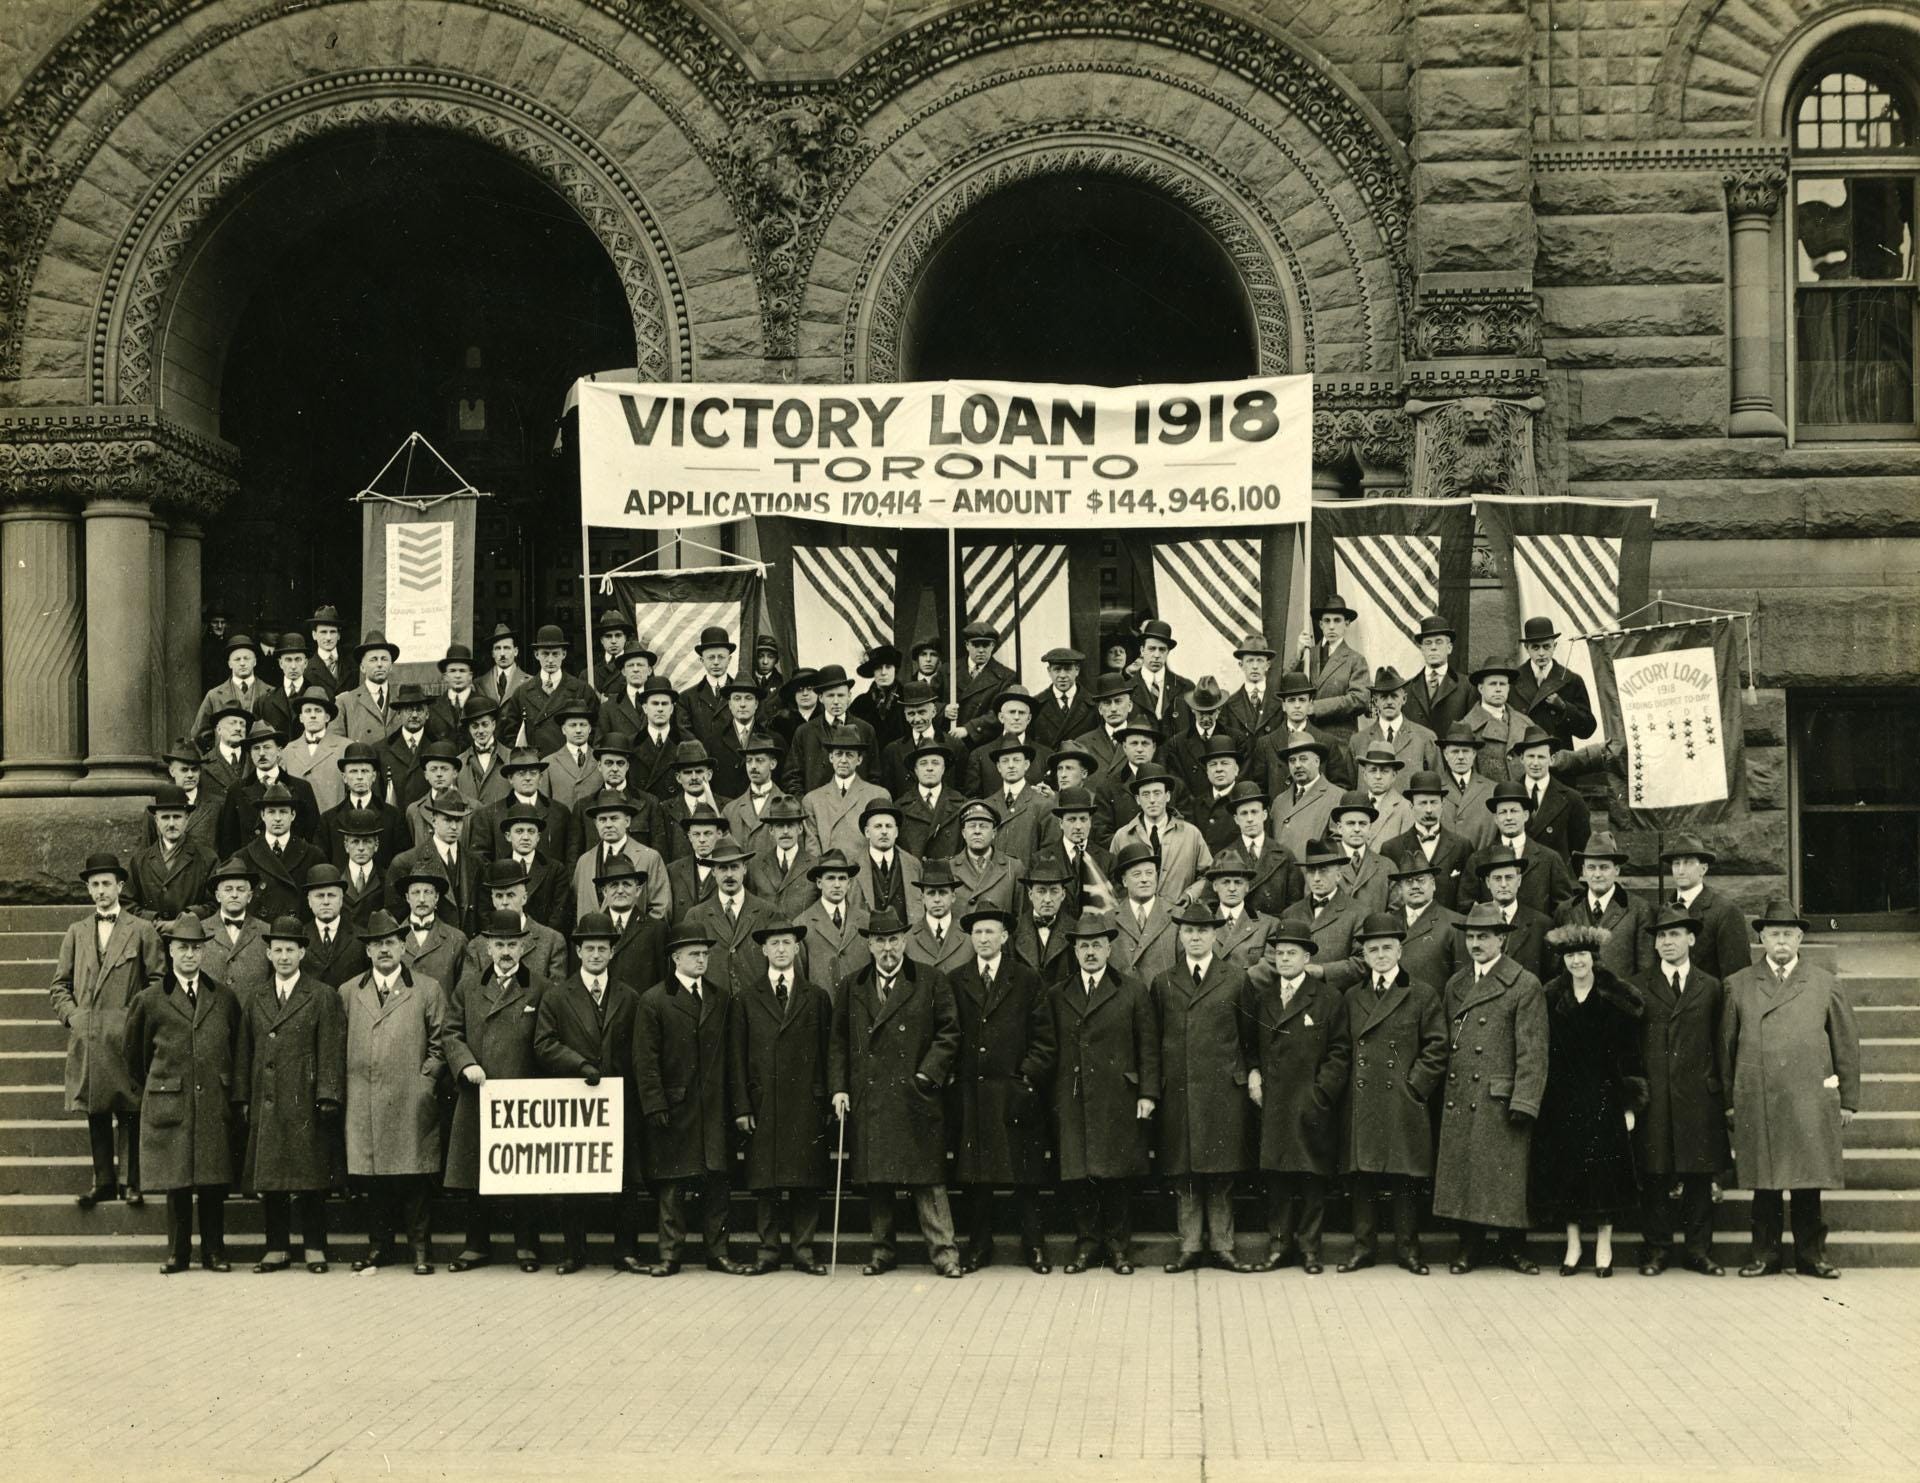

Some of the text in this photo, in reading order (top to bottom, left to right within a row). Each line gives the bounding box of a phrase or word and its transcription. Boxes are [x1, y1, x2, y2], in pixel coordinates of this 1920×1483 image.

[618, 389, 1280, 449] VICTORY LOAN 1918
[773, 453, 1139, 483] TORONTO
[623, 489, 831, 517] APPLICATIONS
[842, 489, 922, 518] 170,414
[952, 488, 1072, 515] AMOUNT
[1086, 484, 1281, 516] $144,946,100
[413, 620, 426, 636] E
[1619, 661, 1713, 698] VICTORY LOAN
[1657, 683, 1676, 695] 1918
[490, 1097, 610, 1129] EXECUTIVE
[488, 1141, 614, 1175] COMMITTEE
